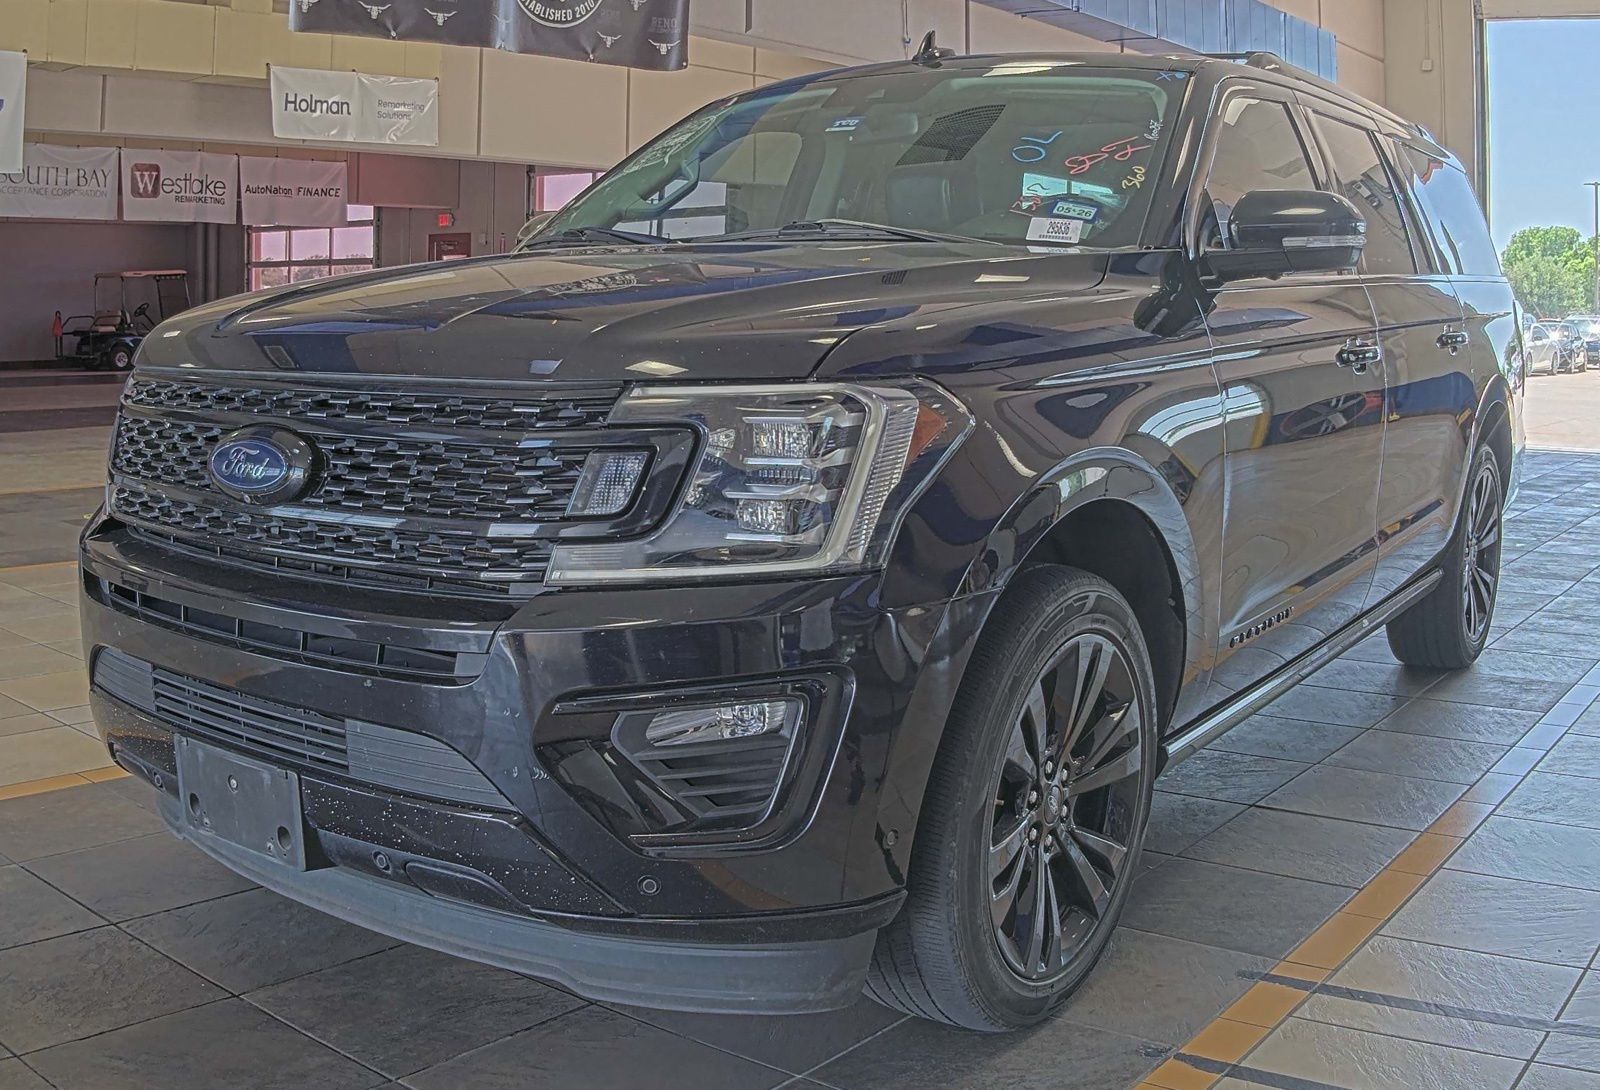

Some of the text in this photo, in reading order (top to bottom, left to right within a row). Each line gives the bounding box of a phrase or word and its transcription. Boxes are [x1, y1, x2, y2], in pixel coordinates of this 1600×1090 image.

[575, 0, 596, 18] 2010
[283, 92, 352, 116] Holman
[377, 99, 425, 112] Remarketing
[377, 110, 412, 121] Solutions
[77, 167, 111, 188] BAY
[133, 171, 226, 197] Westlake
[0, 185, 49, 197] CCEPTANCE
[244, 184, 341, 198] AutoNation FINANCE
[174, 195, 226, 206] REMARKETING
[222, 446, 270, 480] Ford
